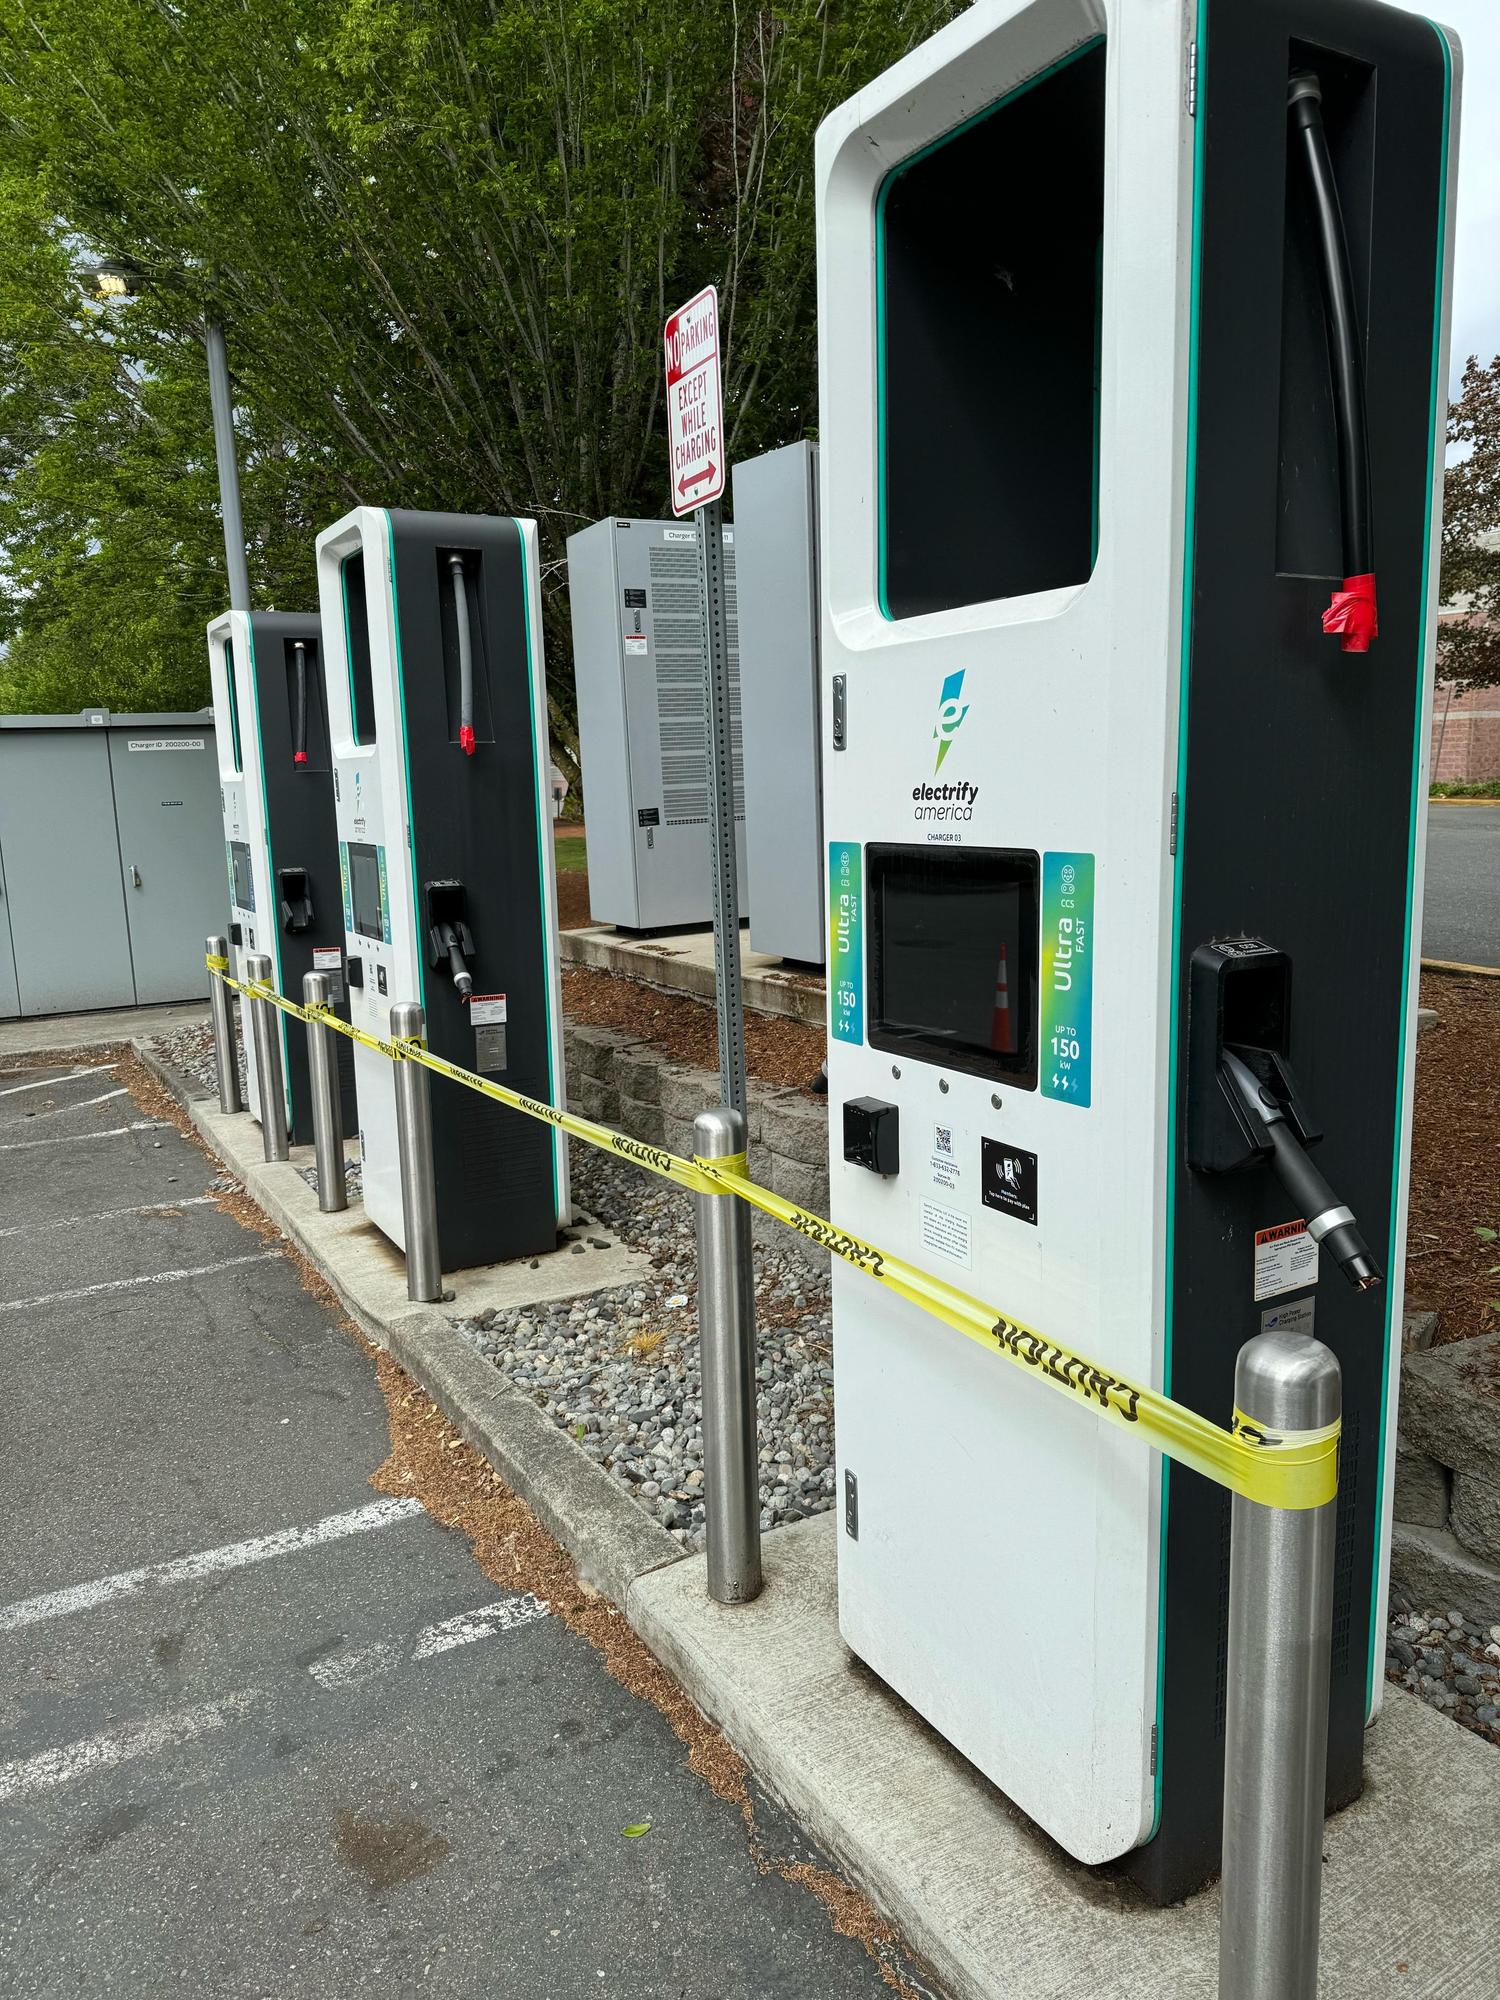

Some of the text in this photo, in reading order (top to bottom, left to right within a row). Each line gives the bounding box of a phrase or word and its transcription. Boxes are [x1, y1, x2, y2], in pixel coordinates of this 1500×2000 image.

[667, 311, 713, 373] NO PARKING
[679, 371, 706, 411] EXCEPT
[681, 402, 706, 438] WHILE
[675, 426, 716, 470] CHARGING
[912, 781, 979, 805] electrify
[914, 803, 973, 820] america
[927, 833, 961, 842] CHARGER 03
[850, 895, 858, 922] FAST
[1060, 898, 1075, 909] CCS
[837, 894, 850, 953] Ultra
[1075, 918, 1086, 953] FAST
[1052, 917, 1073, 991] Ultra
[839, 980, 847, 988] UP
[837, 990, 856, 1008] 150
[1055, 1025, 1077, 1037] UP TO
[1050, 1036, 1080, 1055] 150
[1059, 1060, 1071, 1071] kW
[611, 1133, 672, 1173] CAUTION
[1269, 1222, 1307, 1239] WARNIN
[790, 1210, 885, 1280] CAUTION
[991, 1317, 1141, 1422] CAUTION
